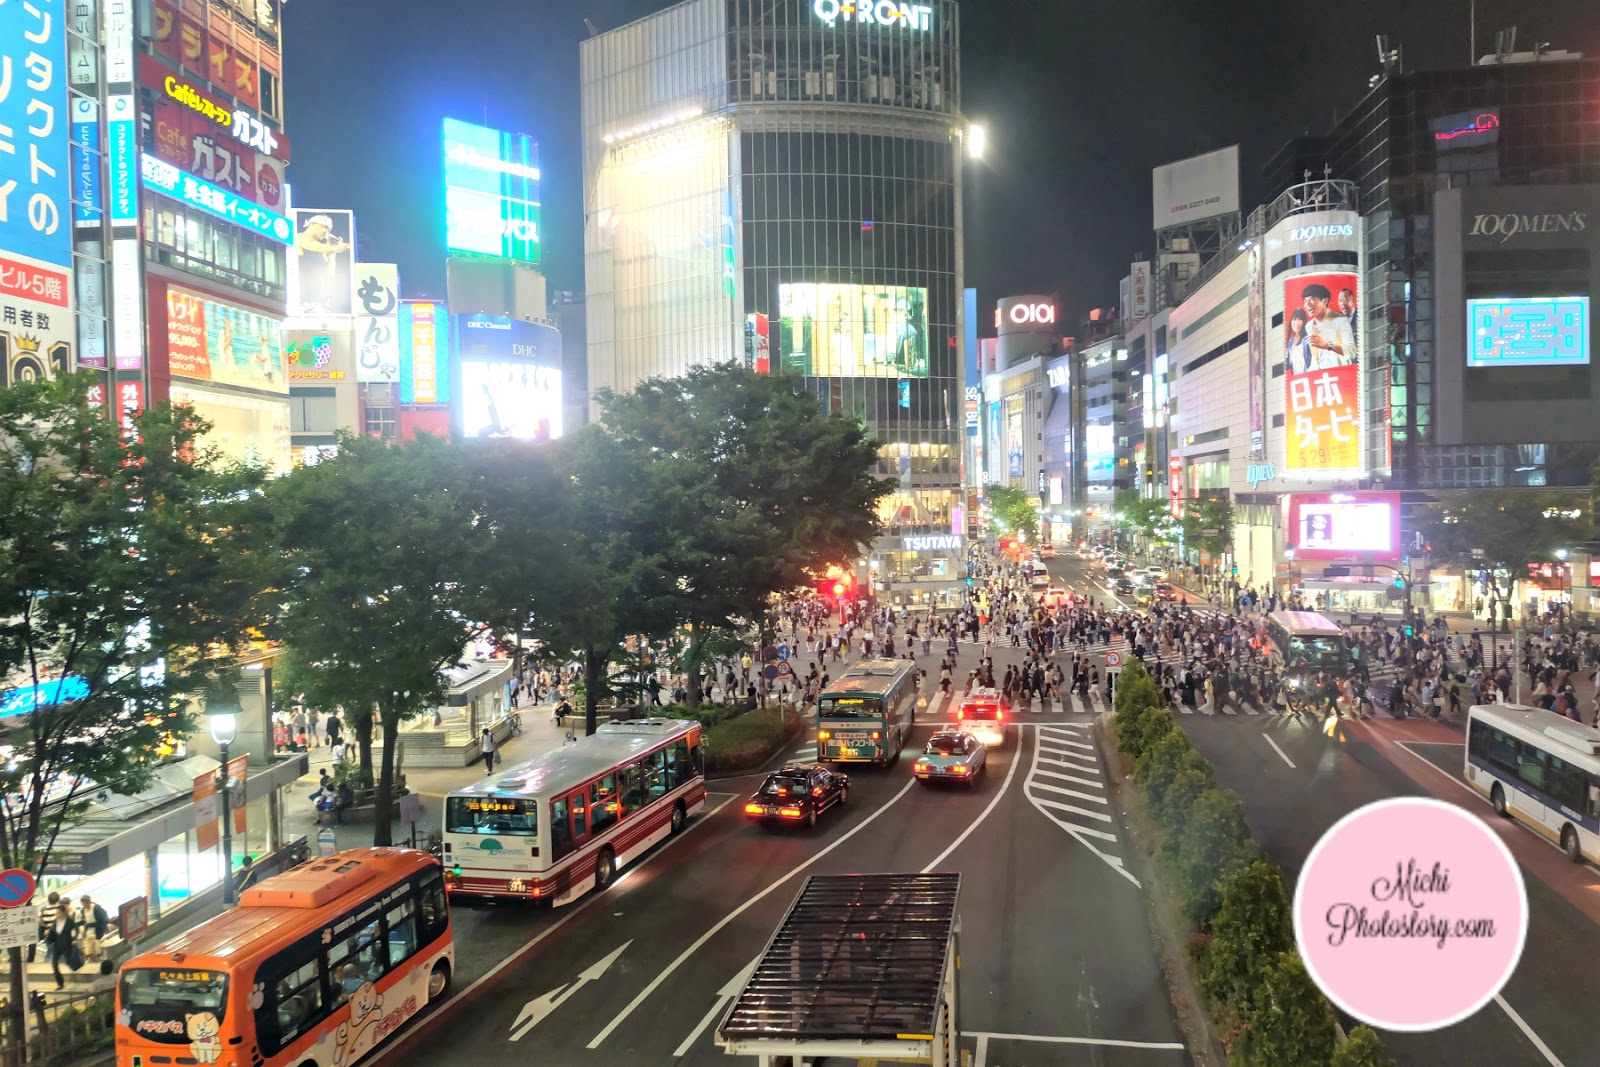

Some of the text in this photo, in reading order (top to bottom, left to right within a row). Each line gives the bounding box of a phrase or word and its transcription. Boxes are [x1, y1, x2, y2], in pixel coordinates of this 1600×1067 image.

[23, 0, 59, 236] ンタクトの
[232, 108, 278, 155] ガスト
[191, 136, 251, 193] ガスト
[1468, 211, 1588, 244] 109MEN'S
[3, 305, 50, 332] 用者数
[356, 275, 398, 380] もんじゃ
[512, 343, 537, 357] DHC
[965, 386, 978, 428] SEIBU
[1290, 372, 1343, 413] 日本
[1294, 408, 1360, 449] ダービー
[903, 535, 962, 550] TSUTAYA
